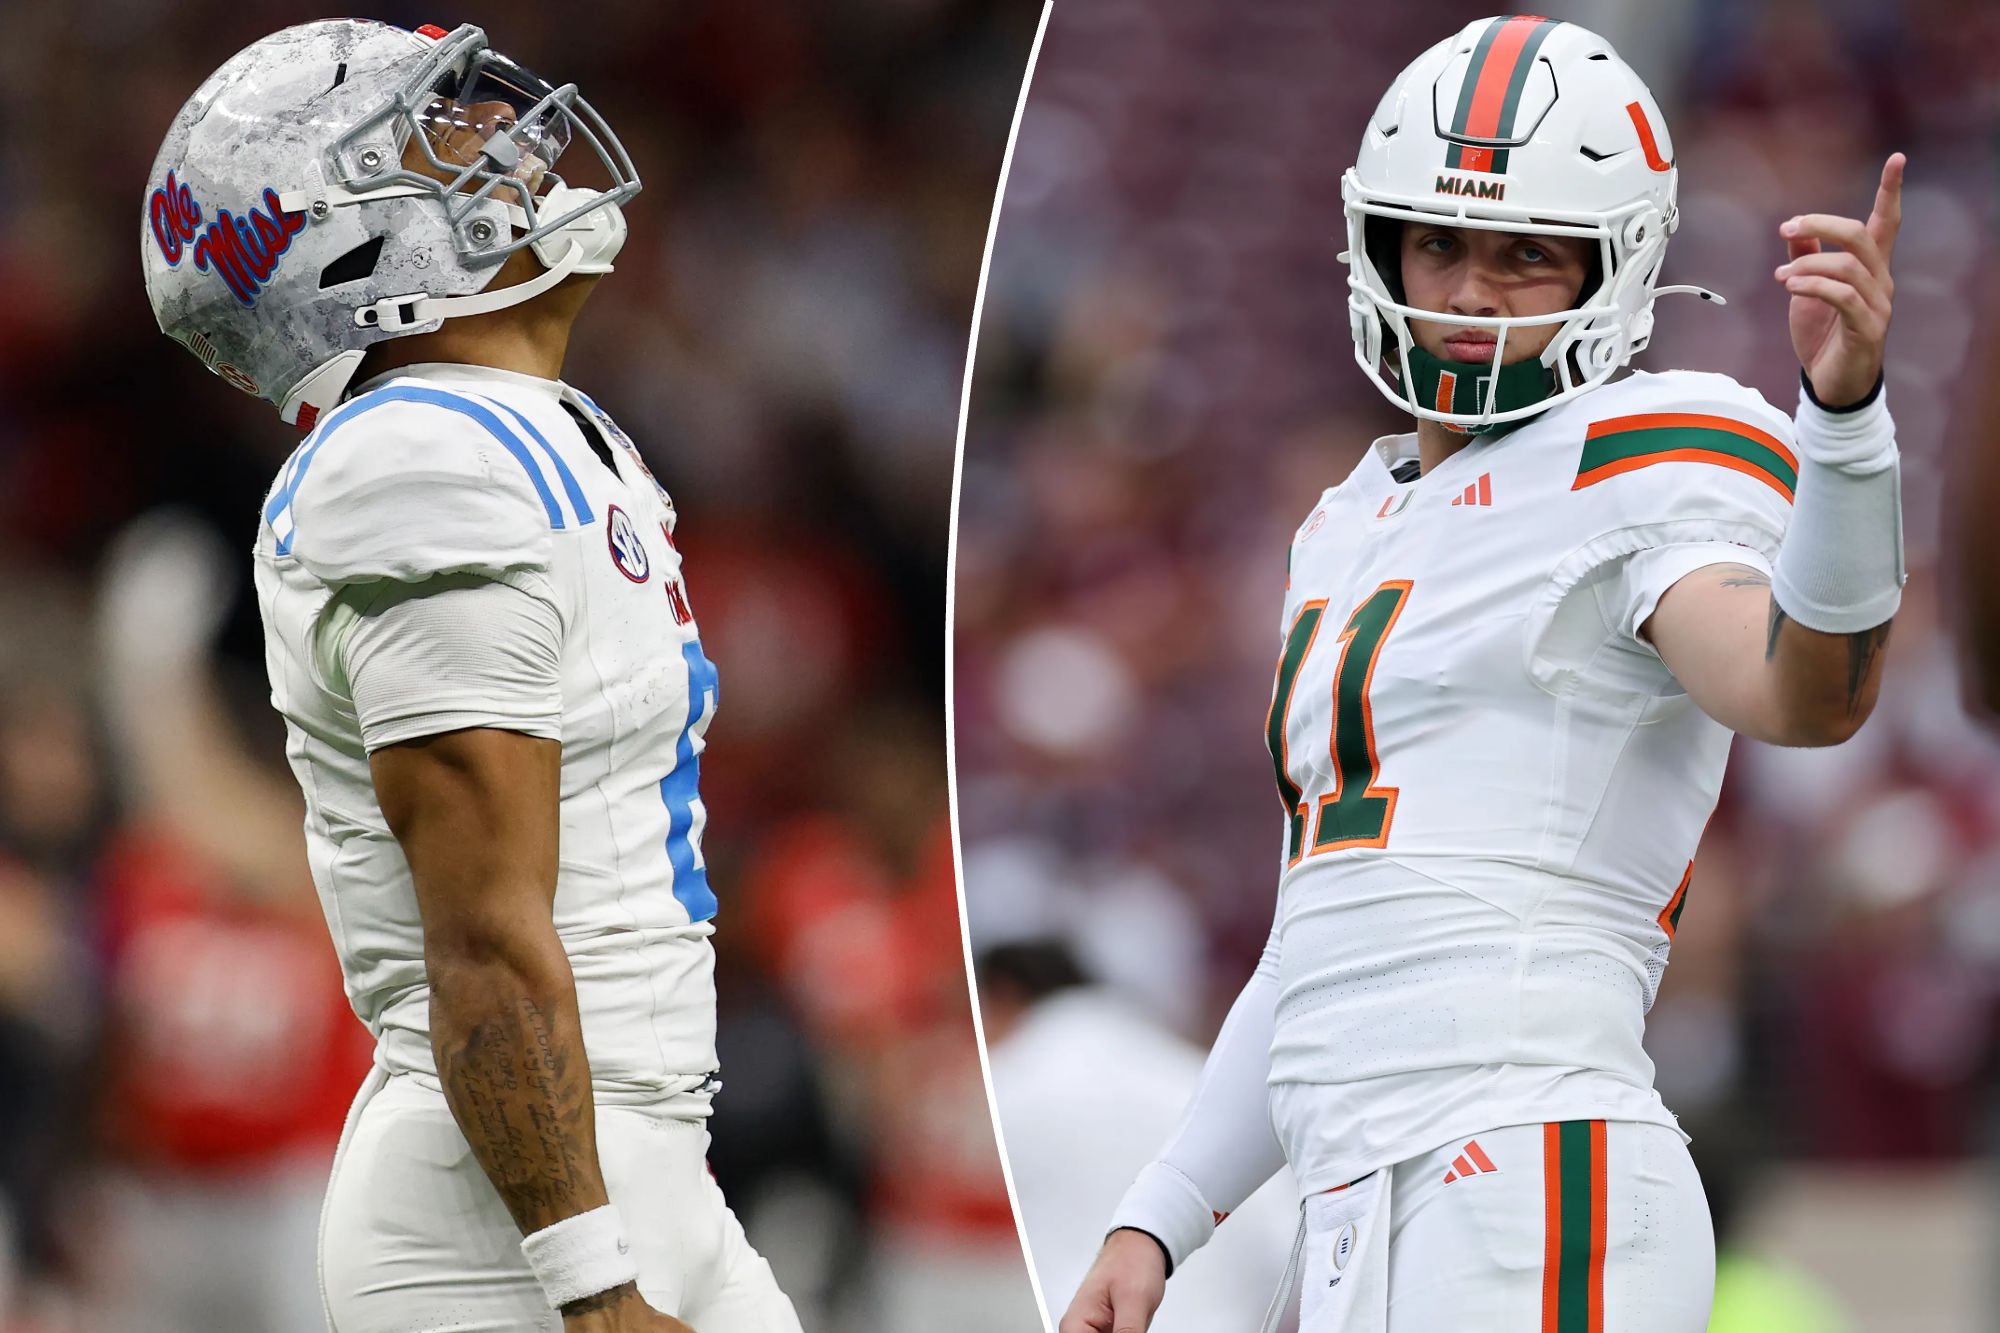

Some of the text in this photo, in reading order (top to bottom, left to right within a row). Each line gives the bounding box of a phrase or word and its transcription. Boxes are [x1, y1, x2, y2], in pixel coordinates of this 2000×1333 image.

[150, 169, 201, 266] Ole
[1434, 175, 1506, 201] MIAMI
[1265, 579, 1414, 873] 11
